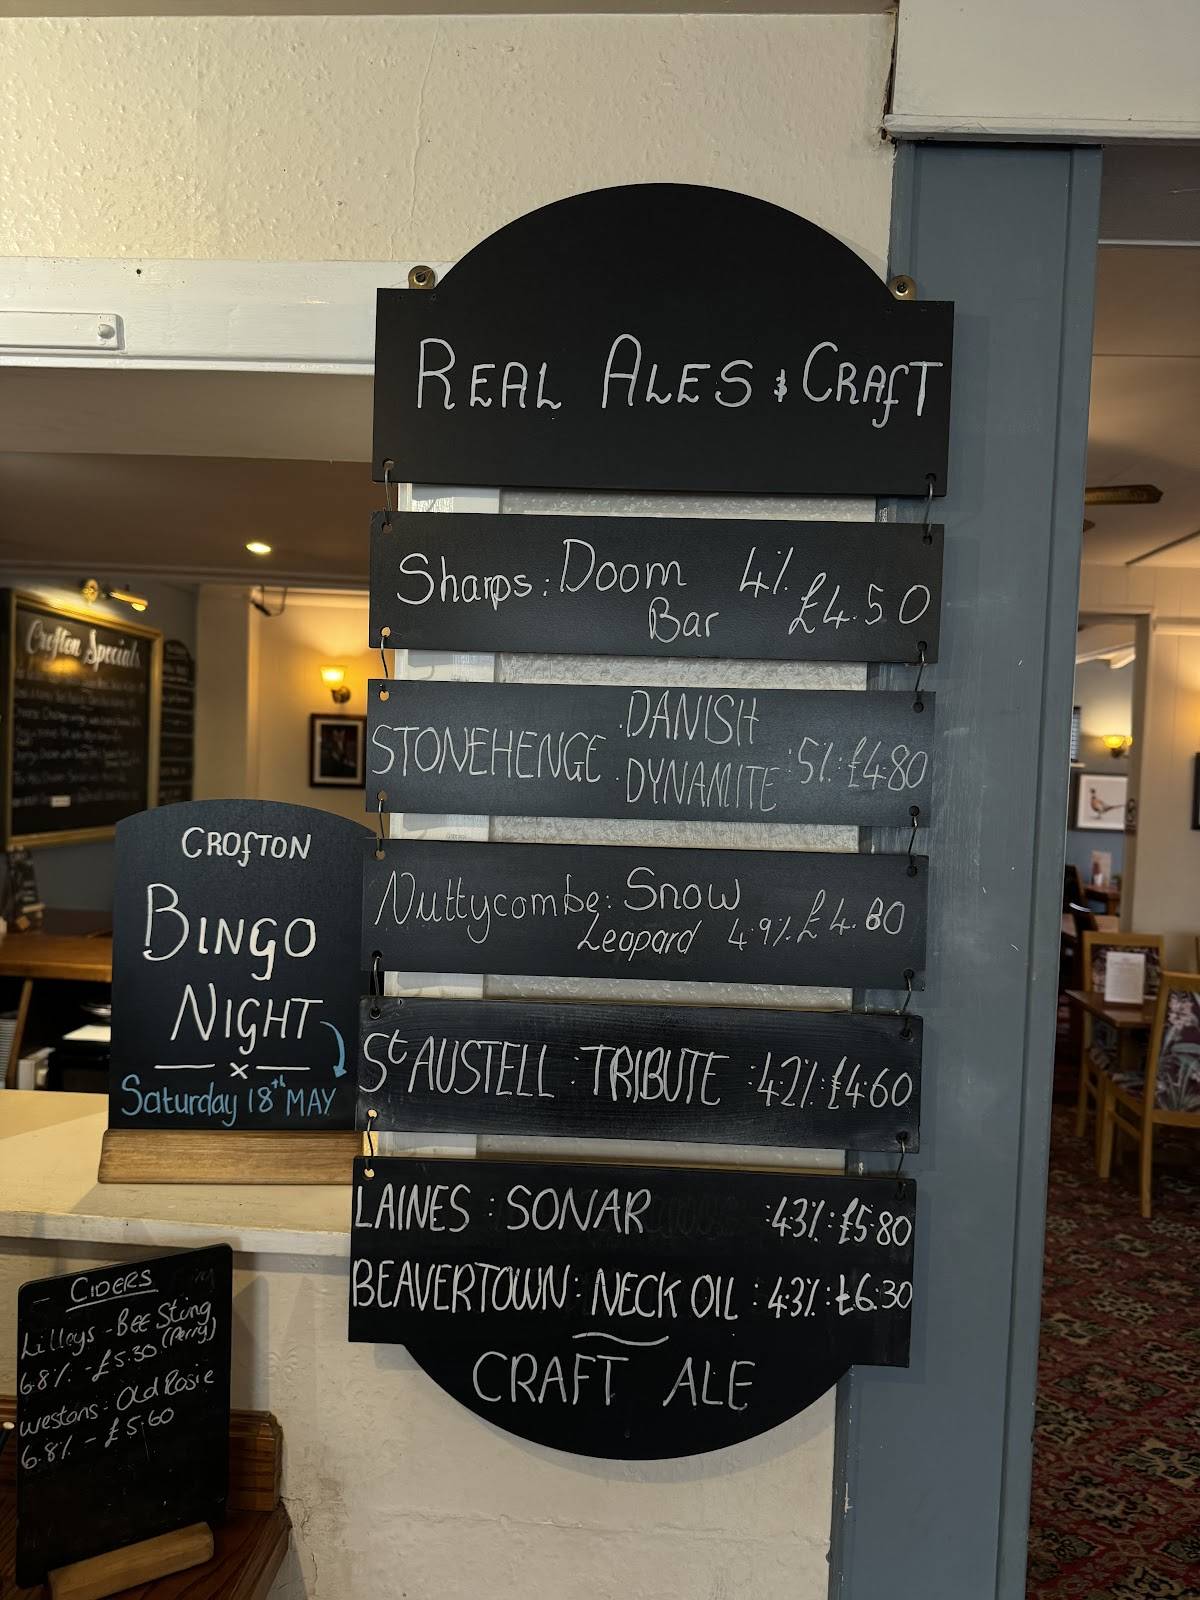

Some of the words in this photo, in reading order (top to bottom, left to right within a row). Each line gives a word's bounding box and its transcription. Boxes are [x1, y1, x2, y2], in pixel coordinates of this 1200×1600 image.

[559, 538, 688, 594] Doom
[647, 597, 720, 643] Bar
[788, 572, 931, 635] £4.50
[626, 689, 760, 747] DANISH
[371, 724, 607, 784] STONEHENGE
[626, 757, 781, 812] DYNAMITE
[624, 866, 741, 911] Snow
[577, 913, 703, 962] Leopard
[407, 1036, 556, 1099] AUSTELL
[120, 1073, 237, 1128] Saturday
[249, 1074, 287, 1114] 18th
[286, 1087, 337, 1117] MAY
[355, 1183, 470, 1233] LAINES
[506, 1184, 652, 1235] SONAR
[156, 1296, 213, 1330] Sting
[591, 1267, 683, 1319] NECK
[690, 1273, 740, 1321] OIL
[116, 1377, 159, 1412] Old
[164, 1362, 216, 1396] Rosie
[472, 1350, 630, 1406] CRAFT
[662, 1355, 756, 1412] ALE
[104, 1408, 175, 1448] £5.60
